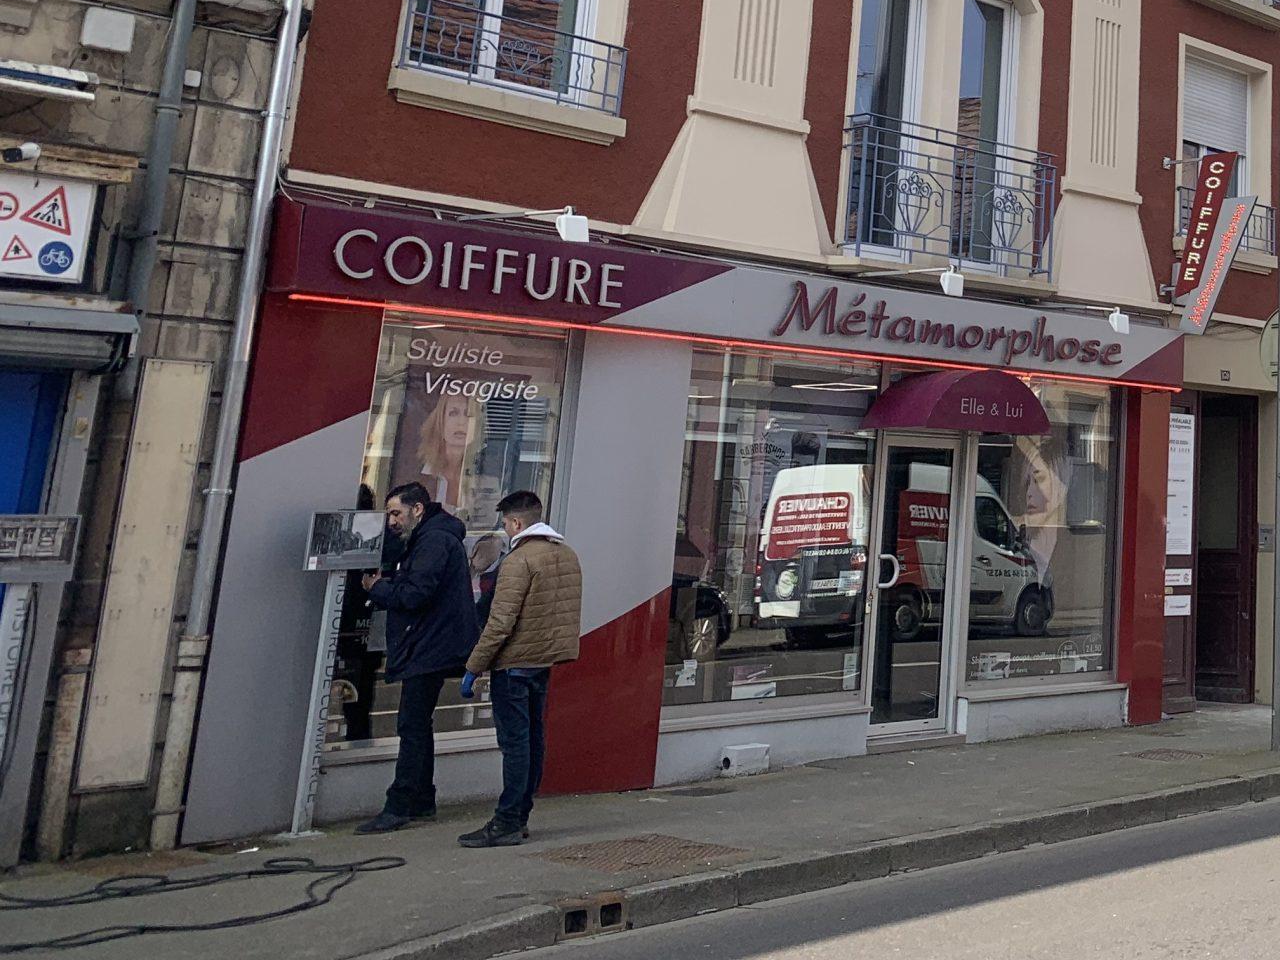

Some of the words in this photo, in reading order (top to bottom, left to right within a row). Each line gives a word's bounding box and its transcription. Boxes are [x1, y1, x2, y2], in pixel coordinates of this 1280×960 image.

[1183, 161, 1225, 281] COIFFURE
[334, 228, 625, 309] COIFFURE
[406, 338, 504, 367] Styliste
[772, 280, 1124, 365] Métamorphose
[424, 372, 539, 403] Visagiste
[961, 398, 984, 416] Elle
[990, 403, 999, 416] &
[1005, 401, 1024, 418] Lui
[2, 597, 27, 693] HISTOIRE
[327, 576, 347, 660] HISTOIRE
[322, 665, 334, 693] DE
